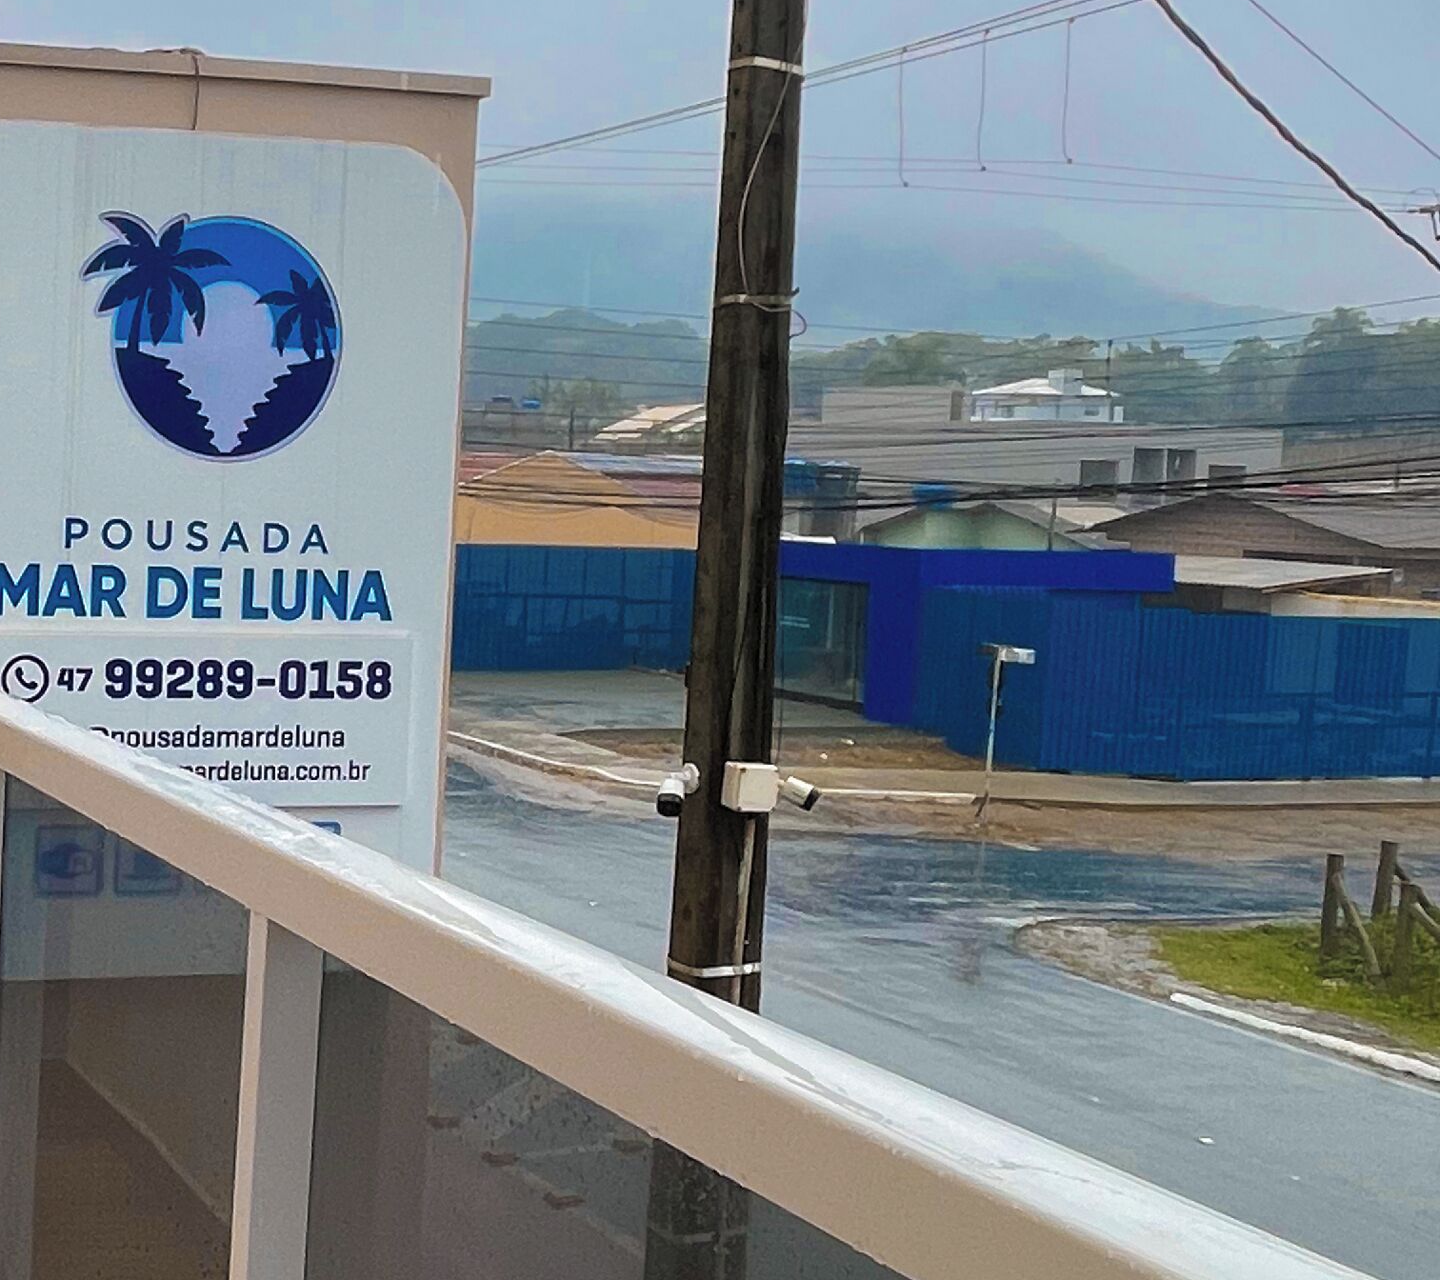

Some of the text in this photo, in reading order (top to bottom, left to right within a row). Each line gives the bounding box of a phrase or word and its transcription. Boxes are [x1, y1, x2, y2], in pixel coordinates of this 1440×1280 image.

[64, 517, 329, 555] POUSADA
[146, 566, 223, 619] DE
[241, 568, 393, 622] LUNA
[56, 658, 392, 700] 47 99289-0158
